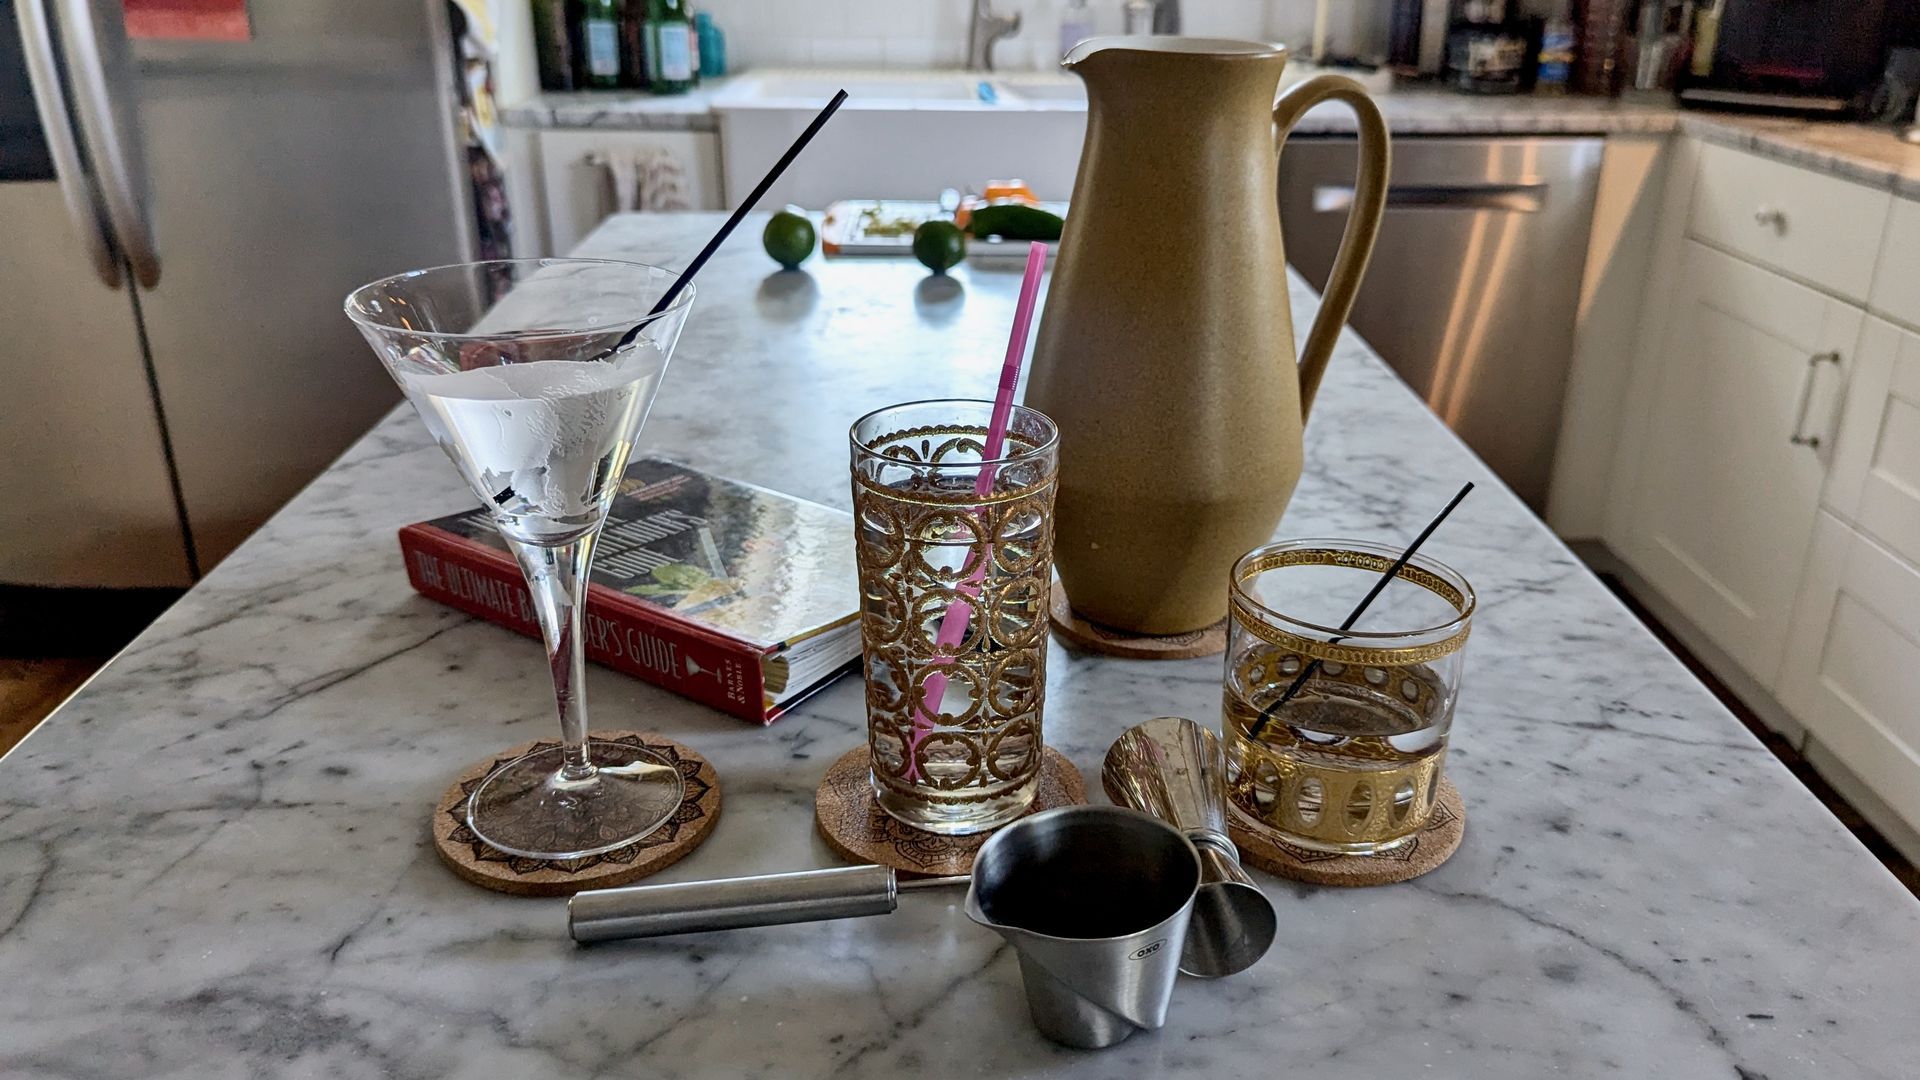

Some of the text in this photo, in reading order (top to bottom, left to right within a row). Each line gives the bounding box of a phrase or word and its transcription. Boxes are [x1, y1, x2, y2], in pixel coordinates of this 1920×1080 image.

[415, 551, 446, 590] THE
[444, 562, 517, 617] ULTIMATE
[626, 628, 682, 680] GUIDE
